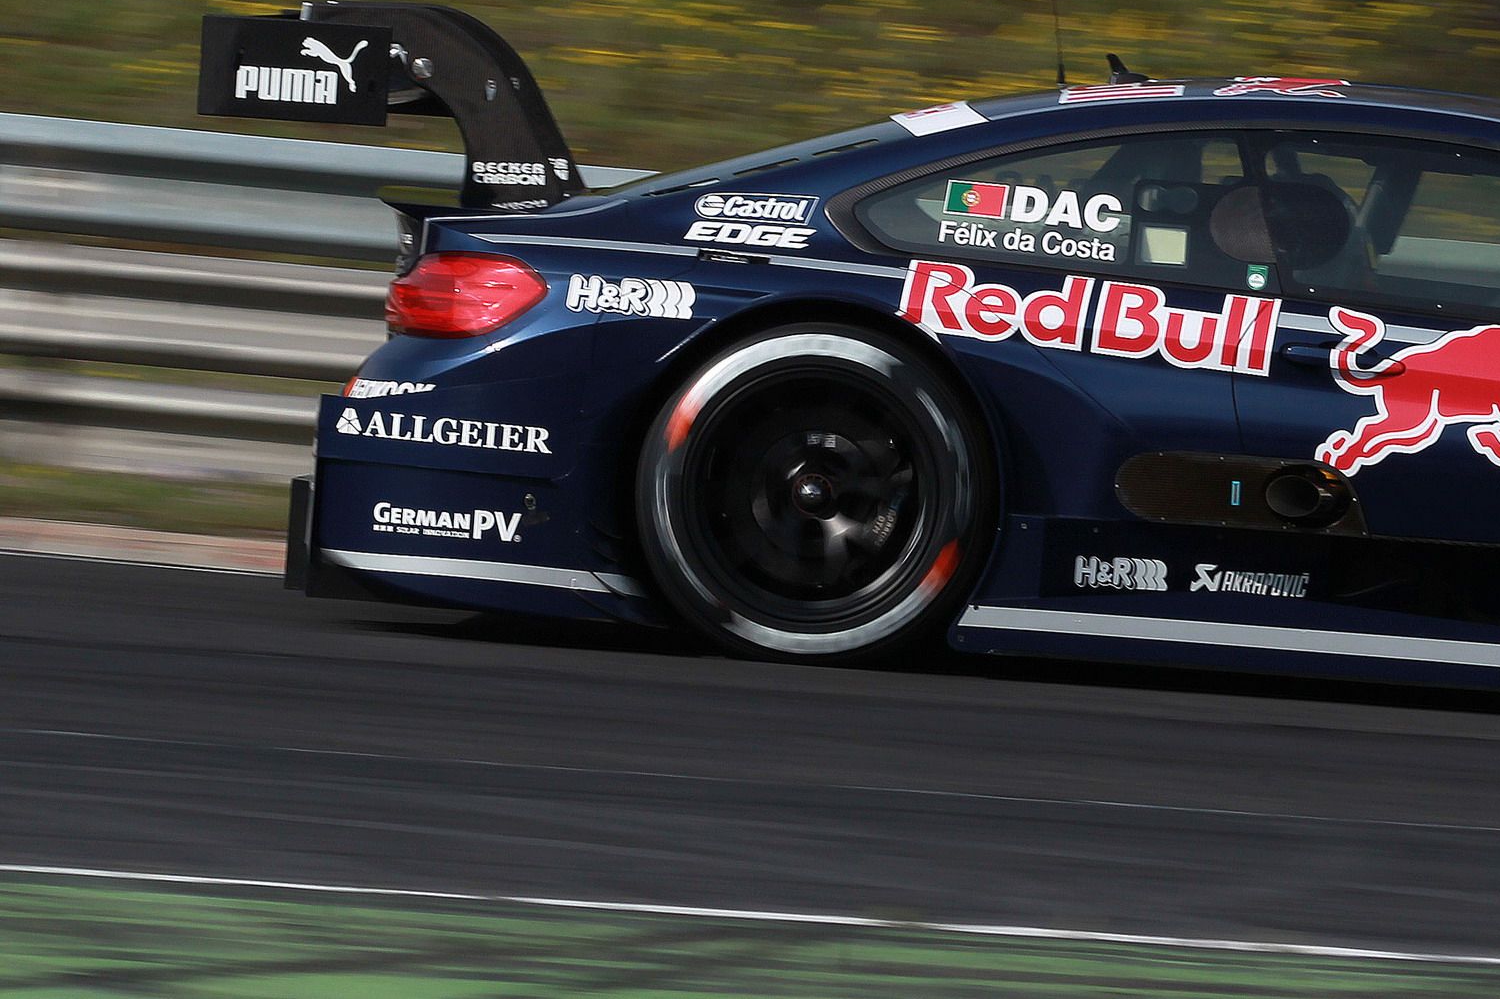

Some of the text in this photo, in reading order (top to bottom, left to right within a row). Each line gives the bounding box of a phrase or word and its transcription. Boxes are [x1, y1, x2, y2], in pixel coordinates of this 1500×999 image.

[235, 65, 339, 105] PUMA
[472, 161, 545, 175] BECKER
[472, 173, 547, 186] CARBON
[722, 195, 809, 221] Castrol
[1010, 185, 1122, 233] DAC
[683, 221, 818, 249] EDGE
[938, 220, 1116, 262] Félix da Costa
[566, 274, 652, 317] H&R
[897, 259, 1282, 377] Red Bull
[362, 411, 553, 455] ALLGEIER
[1074, 555, 1135, 590] H&R
